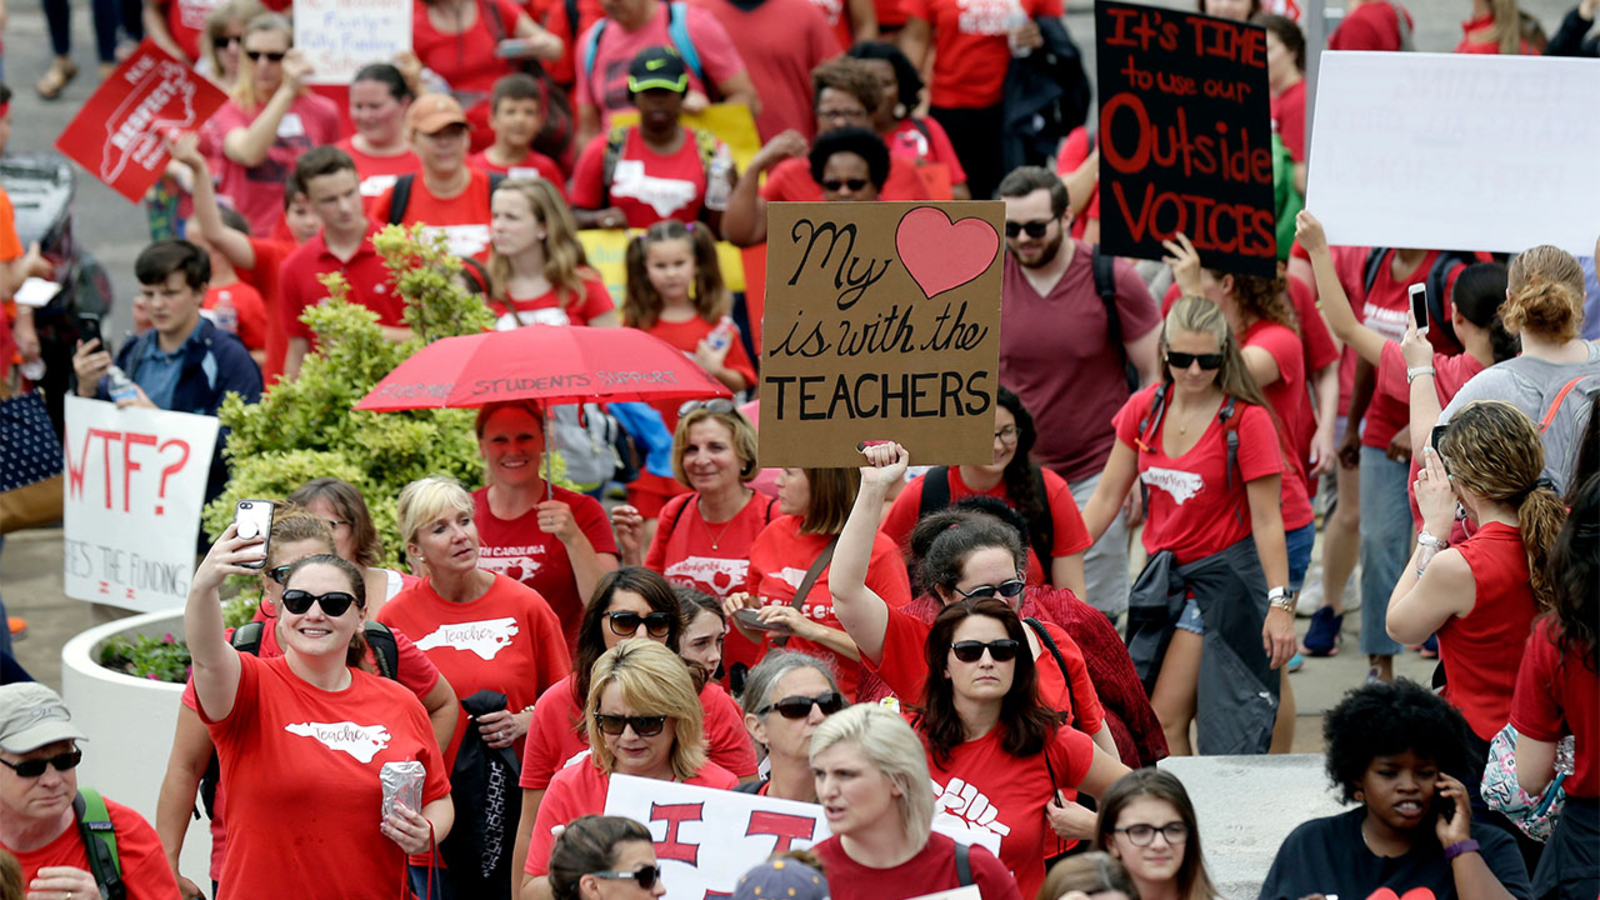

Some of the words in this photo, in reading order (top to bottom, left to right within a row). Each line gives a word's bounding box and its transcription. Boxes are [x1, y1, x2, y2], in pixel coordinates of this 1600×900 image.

[1105, 8, 1179, 51] It's
[1185, 16, 1266, 68] TIME
[1120, 54, 1153, 91] to
[1156, 71, 1198, 96] use
[1203, 78, 1252, 103] our
[111, 79, 177, 150] RESPECT
[1100, 92, 1273, 184] Outside
[1111, 180, 1277, 257] VOICES
[788, 219, 893, 310] My
[770, 310, 832, 358] is
[837, 304, 915, 356] with
[920, 300, 989, 351] the
[470, 373, 591, 396] STUDENTS
[595, 370, 679, 387] SUPPORT
[765, 371, 991, 420] TEACHERS
[64, 420, 190, 515] WTF?
[97, 546, 126, 585] THE
[129, 552, 188, 599] FUNDING
[493, 544, 545, 556] CAROLINA
[444, 624, 495, 643] Teacher
[313, 725, 370, 743] Teacher
